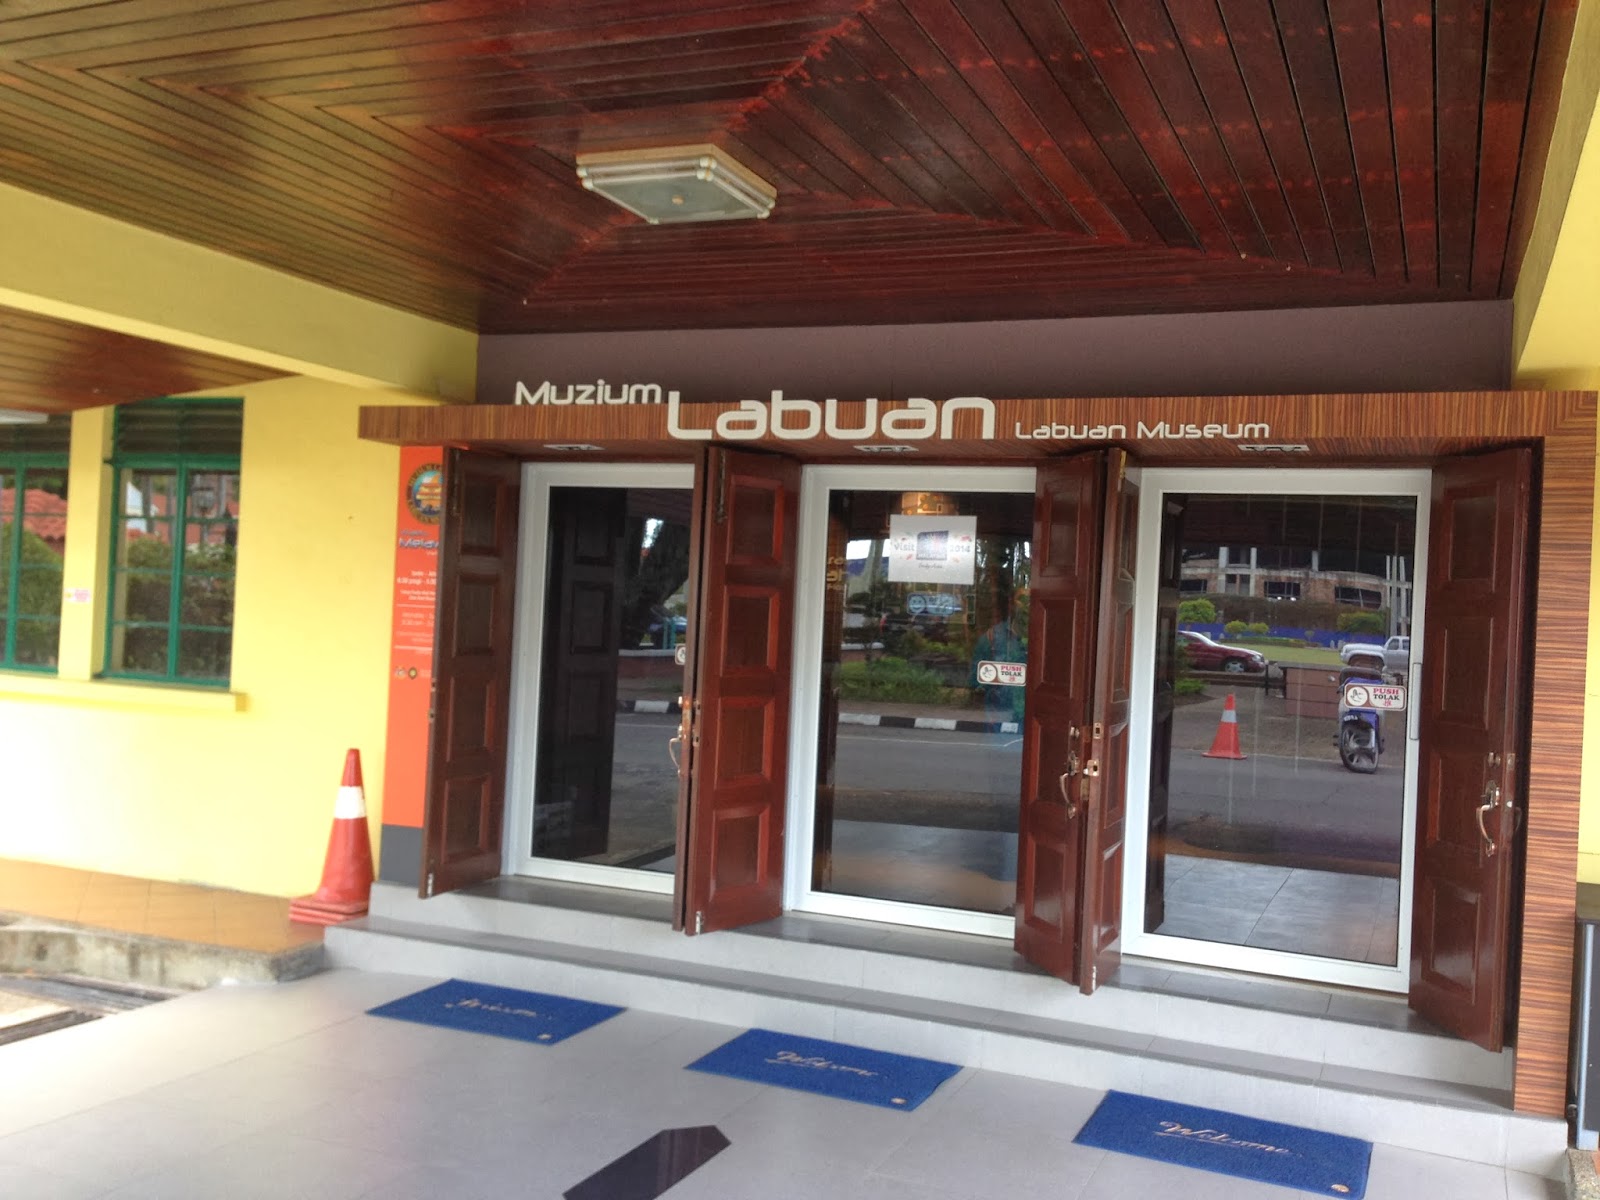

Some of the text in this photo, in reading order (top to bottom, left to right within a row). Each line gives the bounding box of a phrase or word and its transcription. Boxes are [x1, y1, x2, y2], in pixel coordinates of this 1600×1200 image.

[514, 379, 996, 440] Muzium Labuan
[1015, 421, 1270, 439] Labuan Museum
